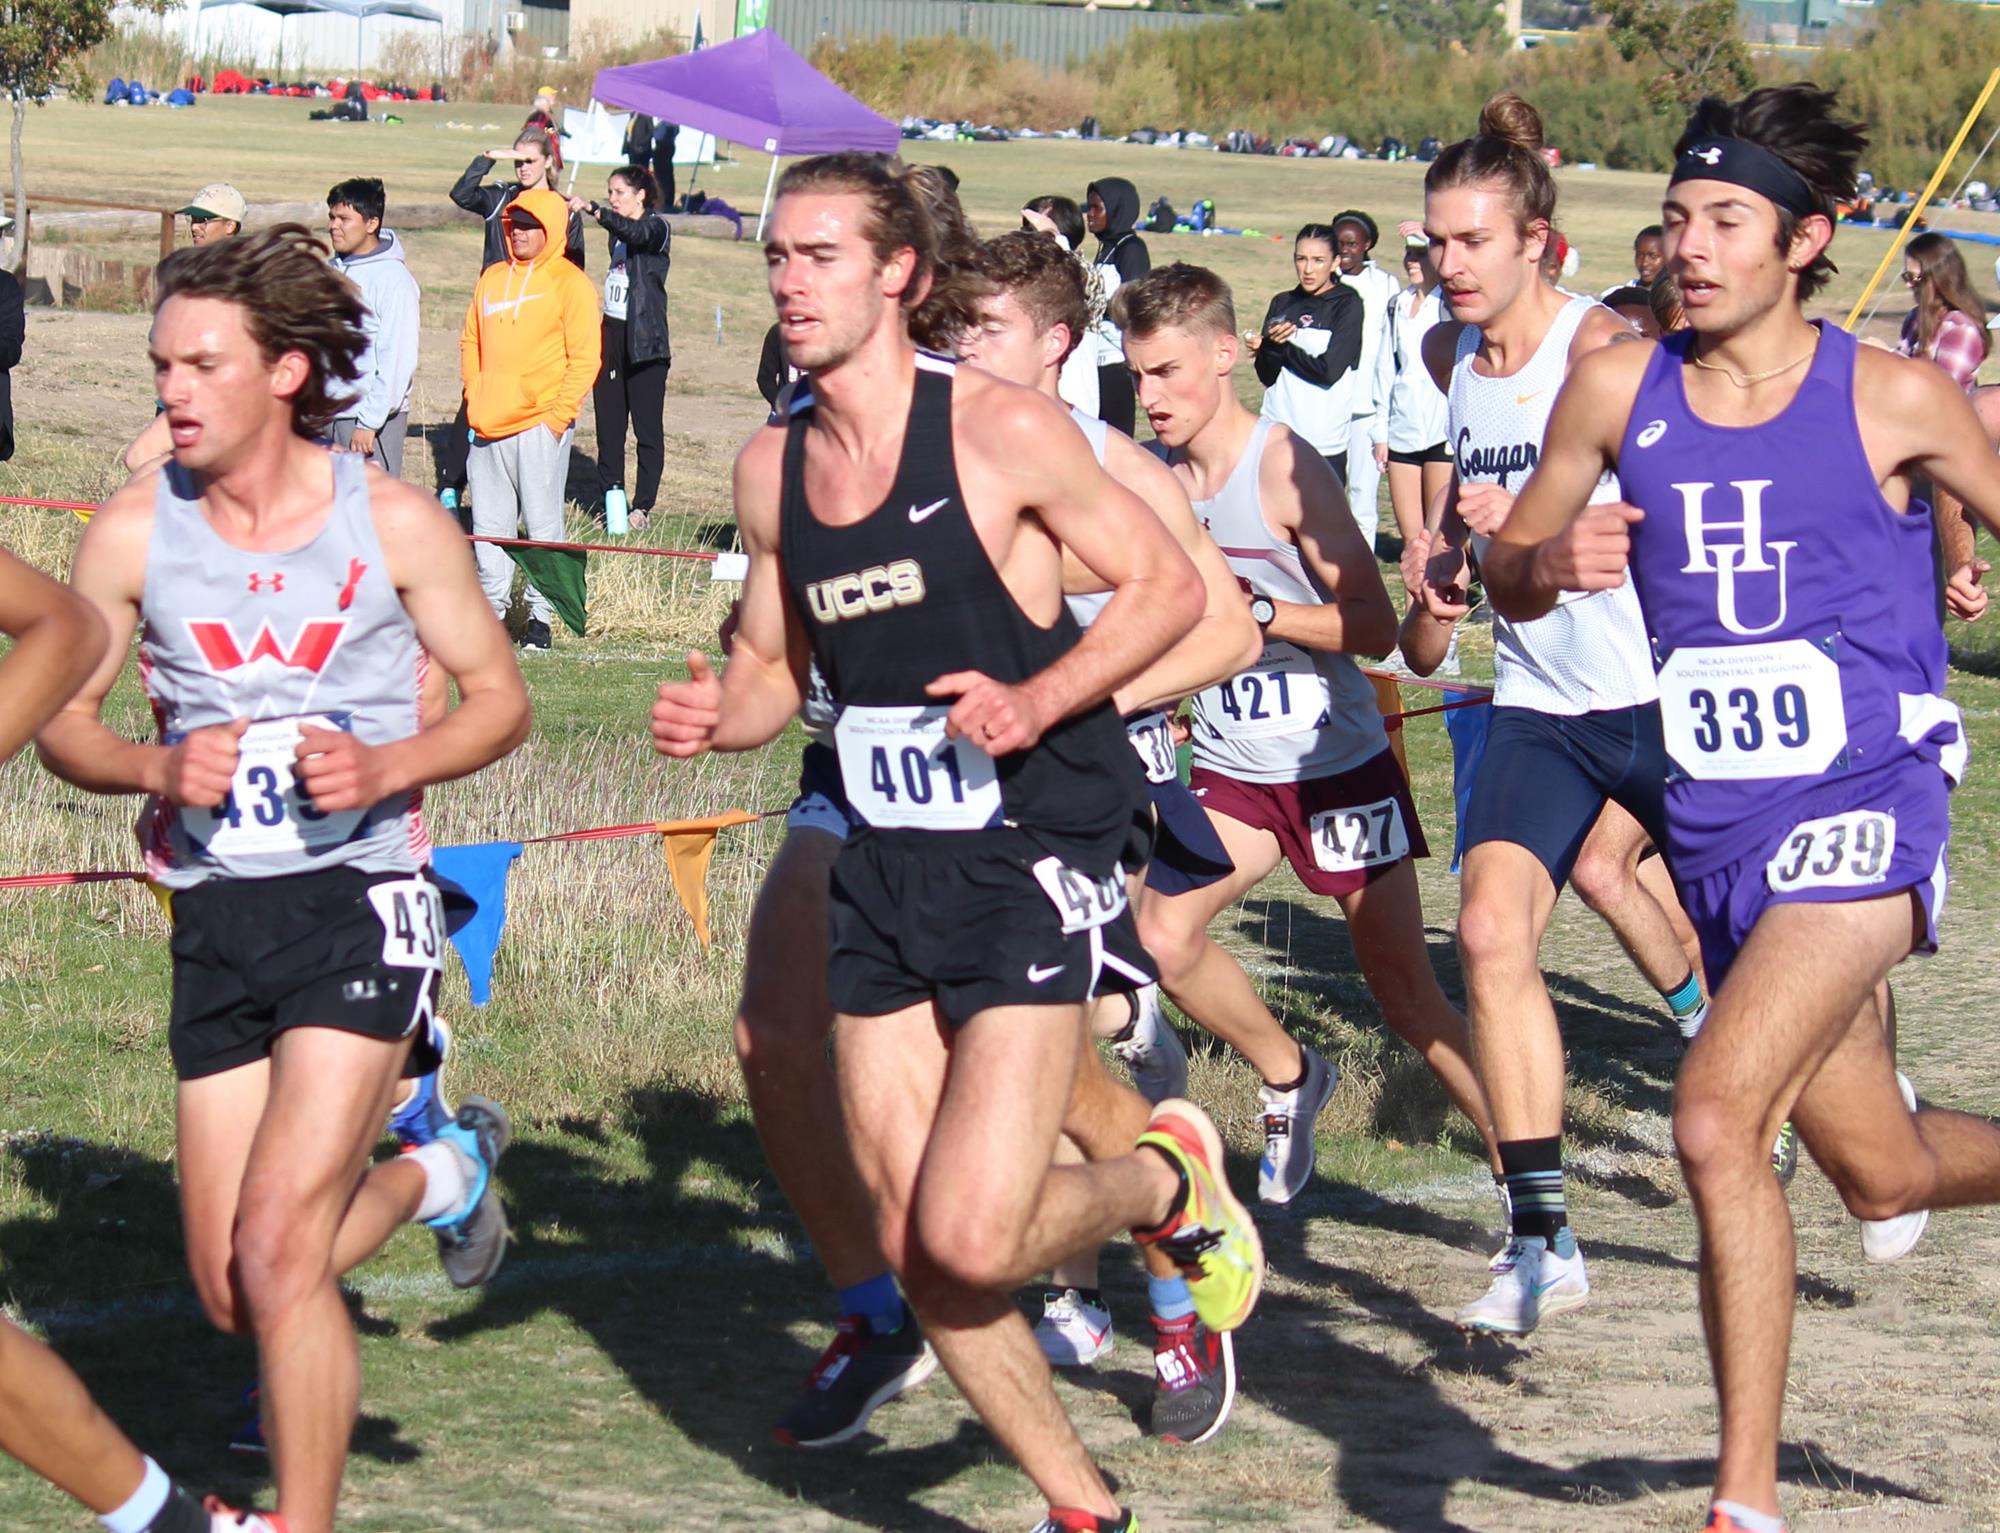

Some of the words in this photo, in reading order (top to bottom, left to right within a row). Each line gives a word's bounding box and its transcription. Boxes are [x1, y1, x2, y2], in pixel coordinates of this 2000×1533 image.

[805, 558, 926, 625] UCCS
[1675, 669, 1708, 678] SOUTH
[1710, 666, 1755, 677] CENTRAL
[1758, 662, 1813, 674] REGIONAL
[1697, 656, 1726, 666] NCAA
[1728, 653, 1775, 664] DIVISION
[1219, 670, 1292, 721] 427
[1689, 683, 1811, 753] 339
[871, 744, 964, 805] 401
[1322, 803, 1394, 861] 427
[1778, 818, 1886, 882] 339
[1056, 866, 1126, 920] 40
